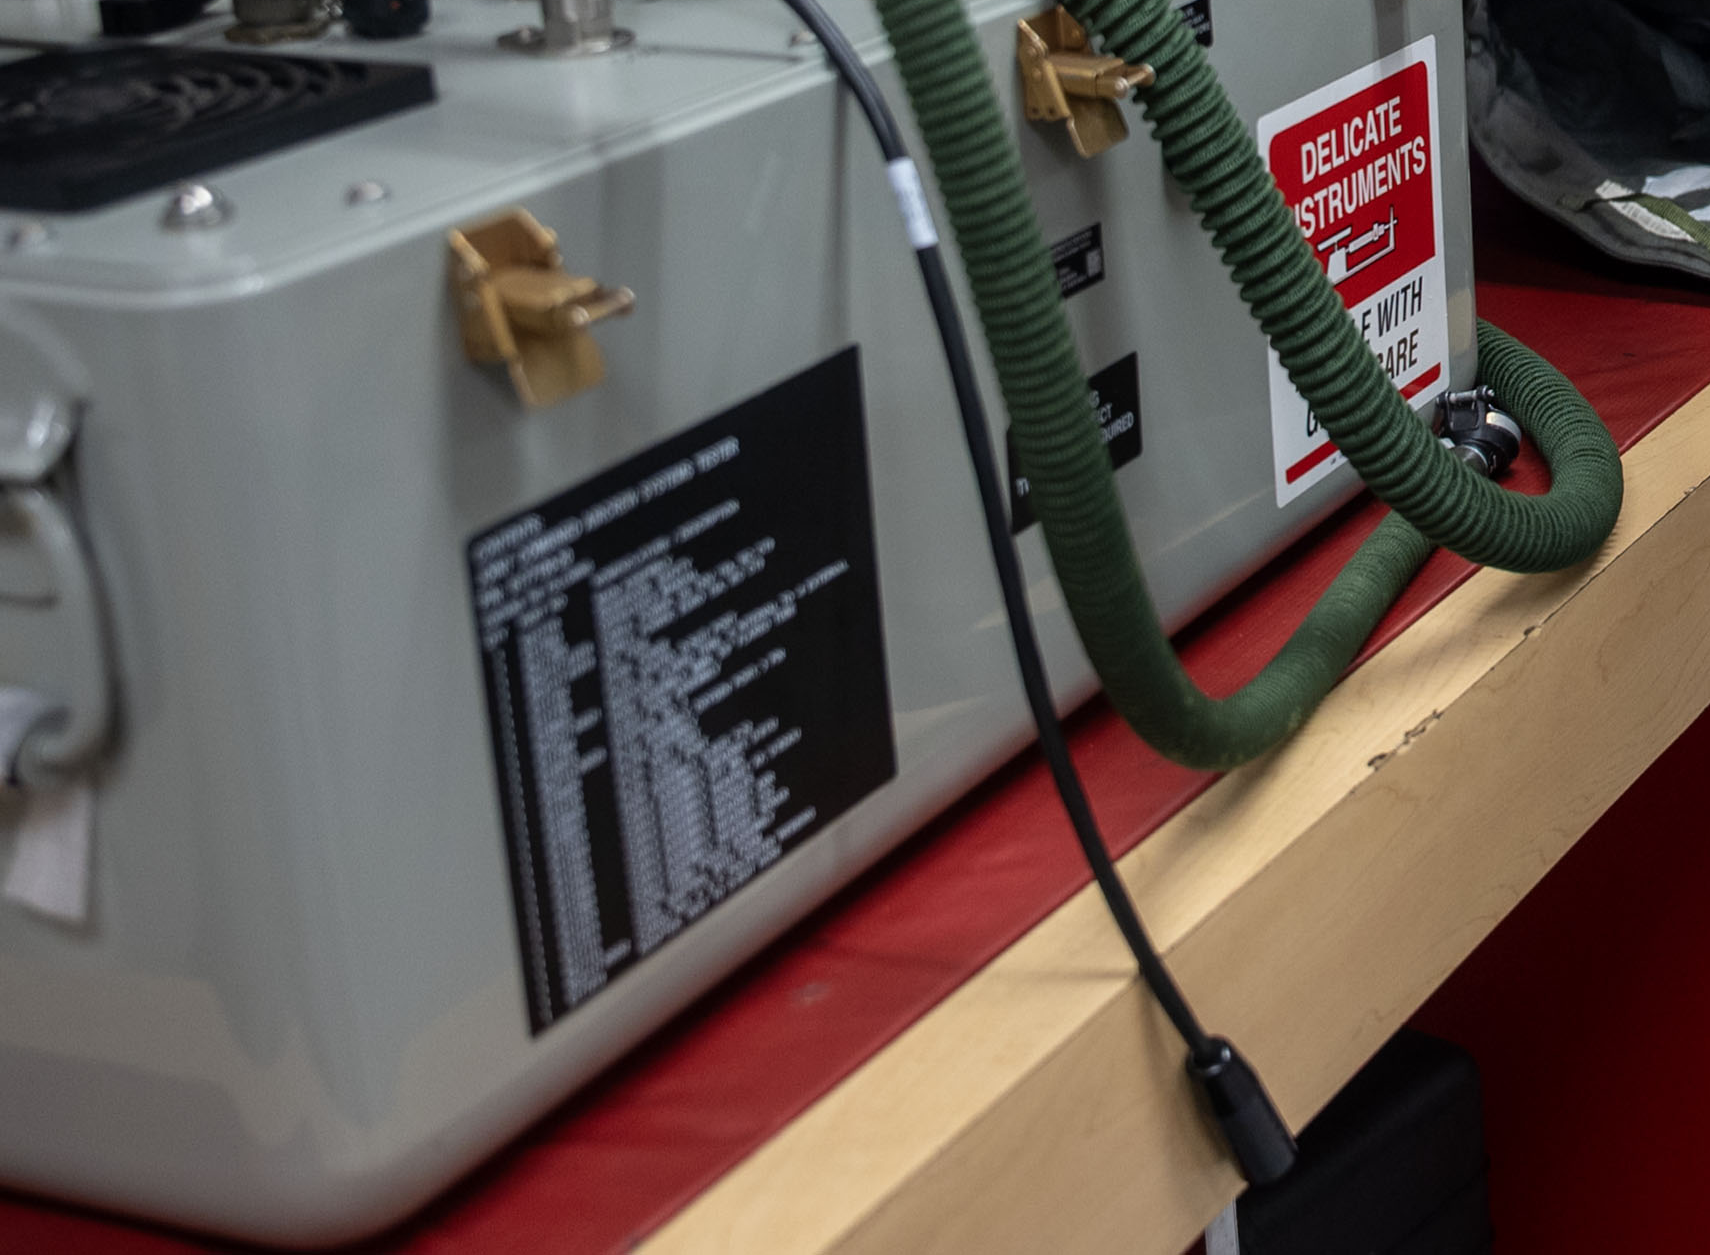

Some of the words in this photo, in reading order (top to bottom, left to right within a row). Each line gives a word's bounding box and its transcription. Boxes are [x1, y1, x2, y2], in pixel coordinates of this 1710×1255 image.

[1301, 96, 1402, 184] DELICATE
[1294, 136, 1426, 238] STRUMENTS
[1377, 276, 1423, 338] WITH
